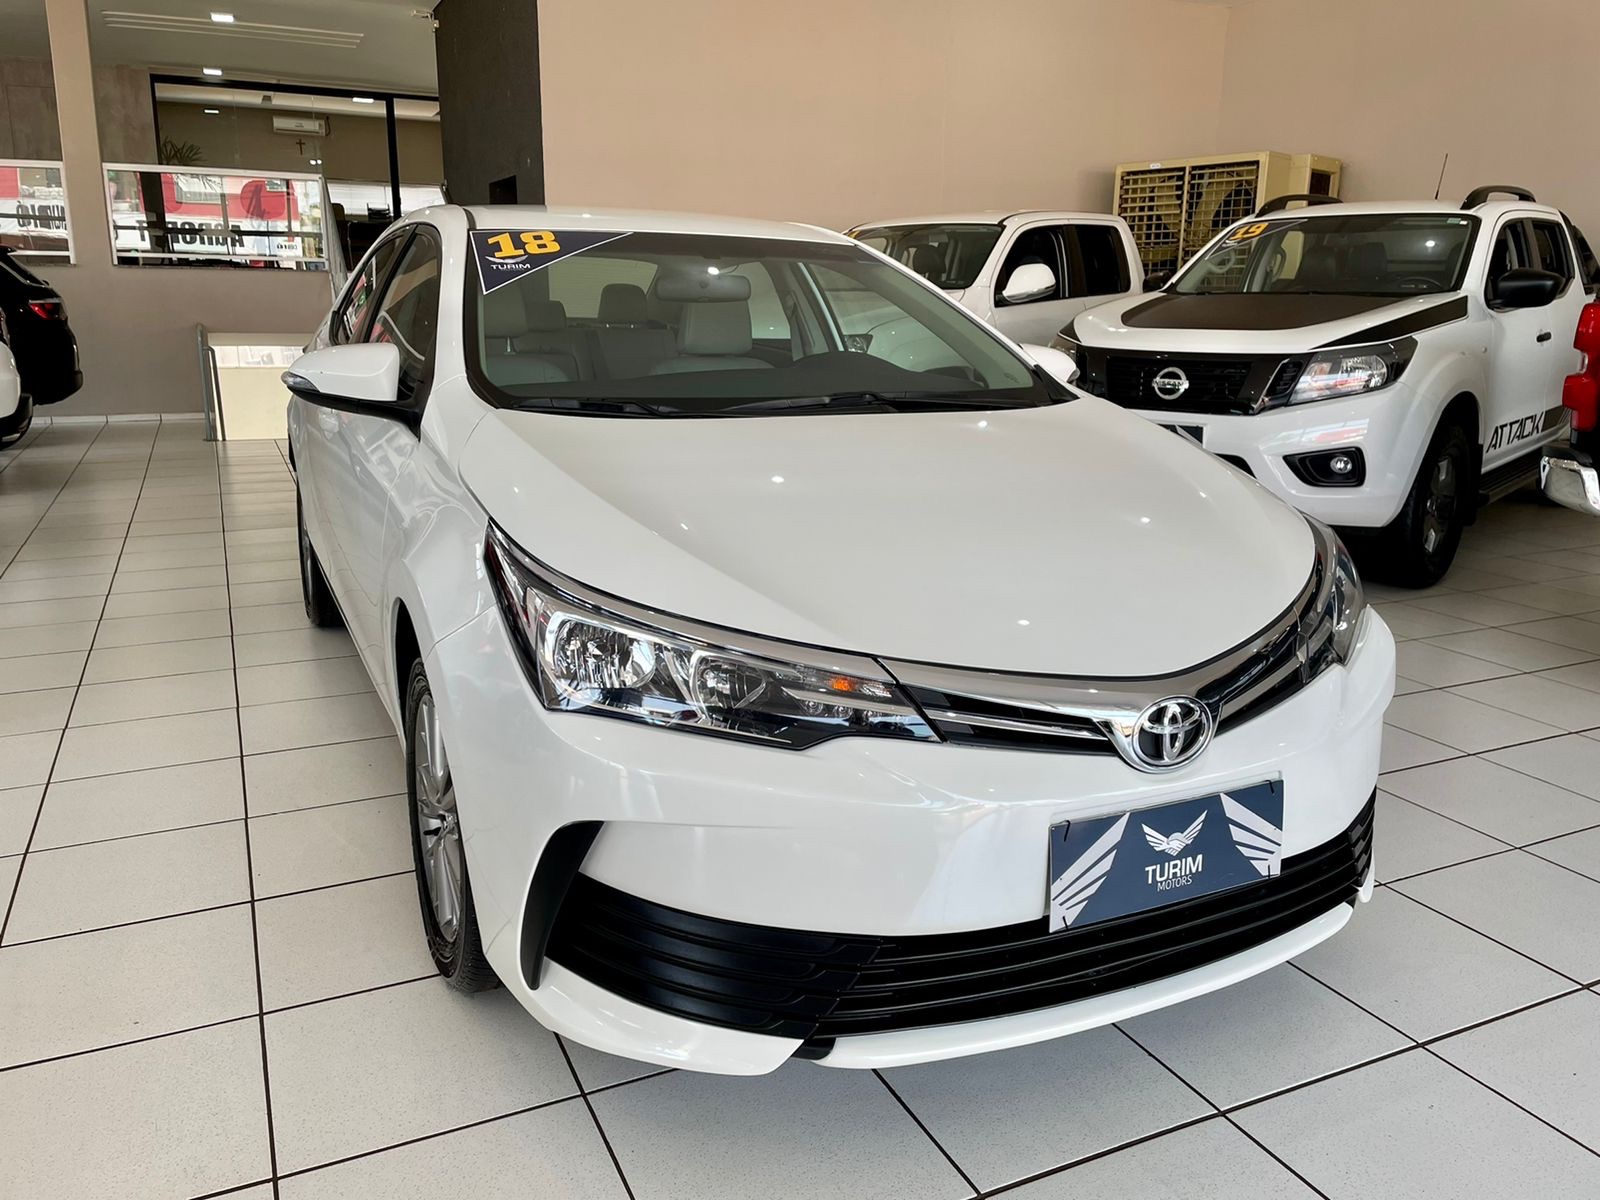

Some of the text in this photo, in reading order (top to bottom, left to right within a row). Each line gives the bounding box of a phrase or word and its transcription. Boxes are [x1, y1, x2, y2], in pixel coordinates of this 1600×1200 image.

[487, 230, 561, 258] 18
[1230, 222, 1269, 240] 19
[1486, 411, 1544, 454] ATTACK
[1144, 854, 1203, 884] TURIM
[1157, 875, 1193, 892] MOTORS
